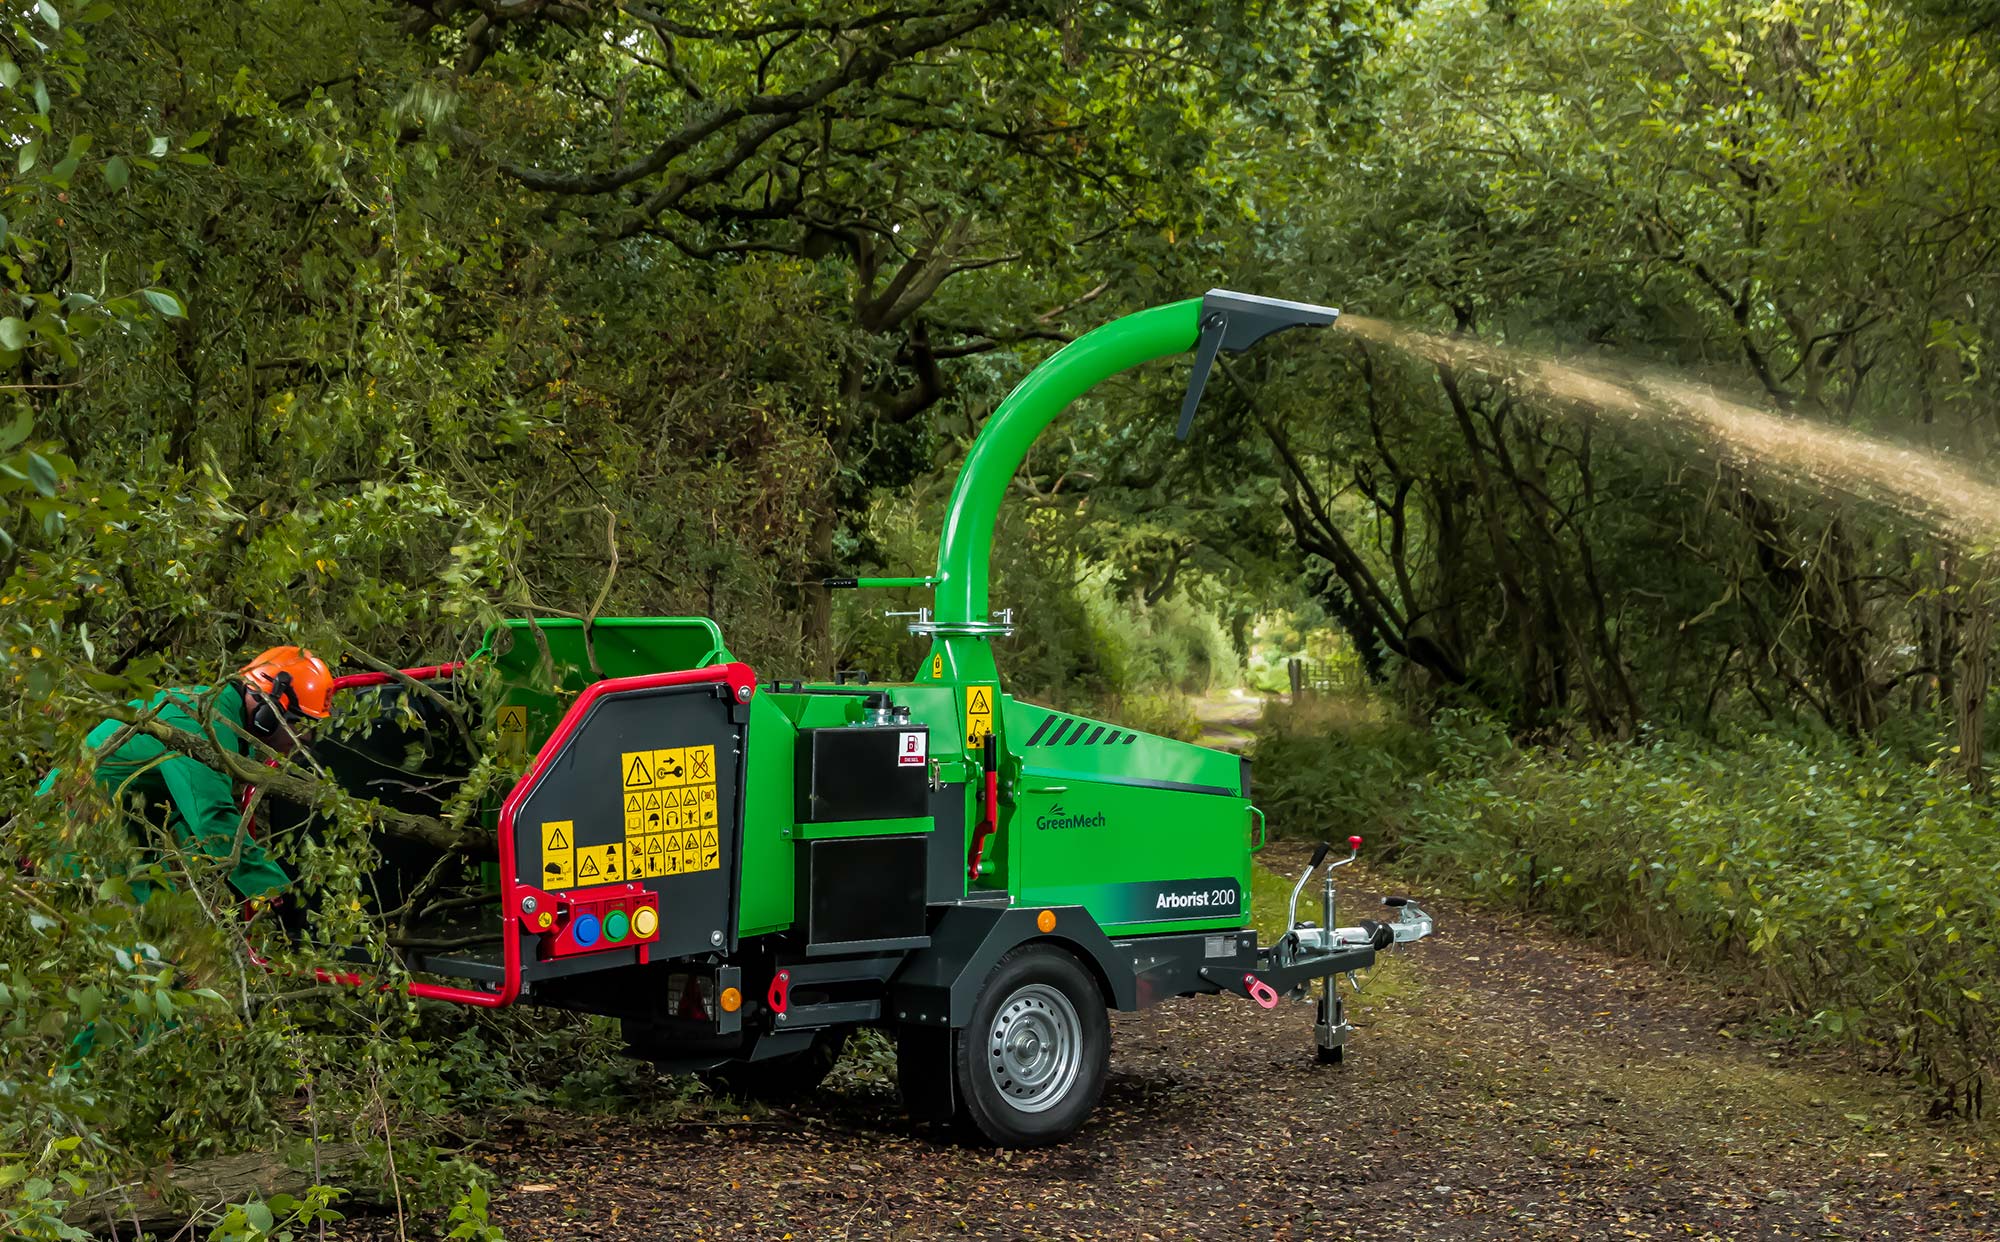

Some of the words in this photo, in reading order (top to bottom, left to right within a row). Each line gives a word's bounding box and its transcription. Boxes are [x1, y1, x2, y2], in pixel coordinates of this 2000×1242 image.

[1036, 811, 1106, 831] GreenMech
[1156, 891, 1209, 908] Arborist
[1211, 889, 1235, 906] 200
